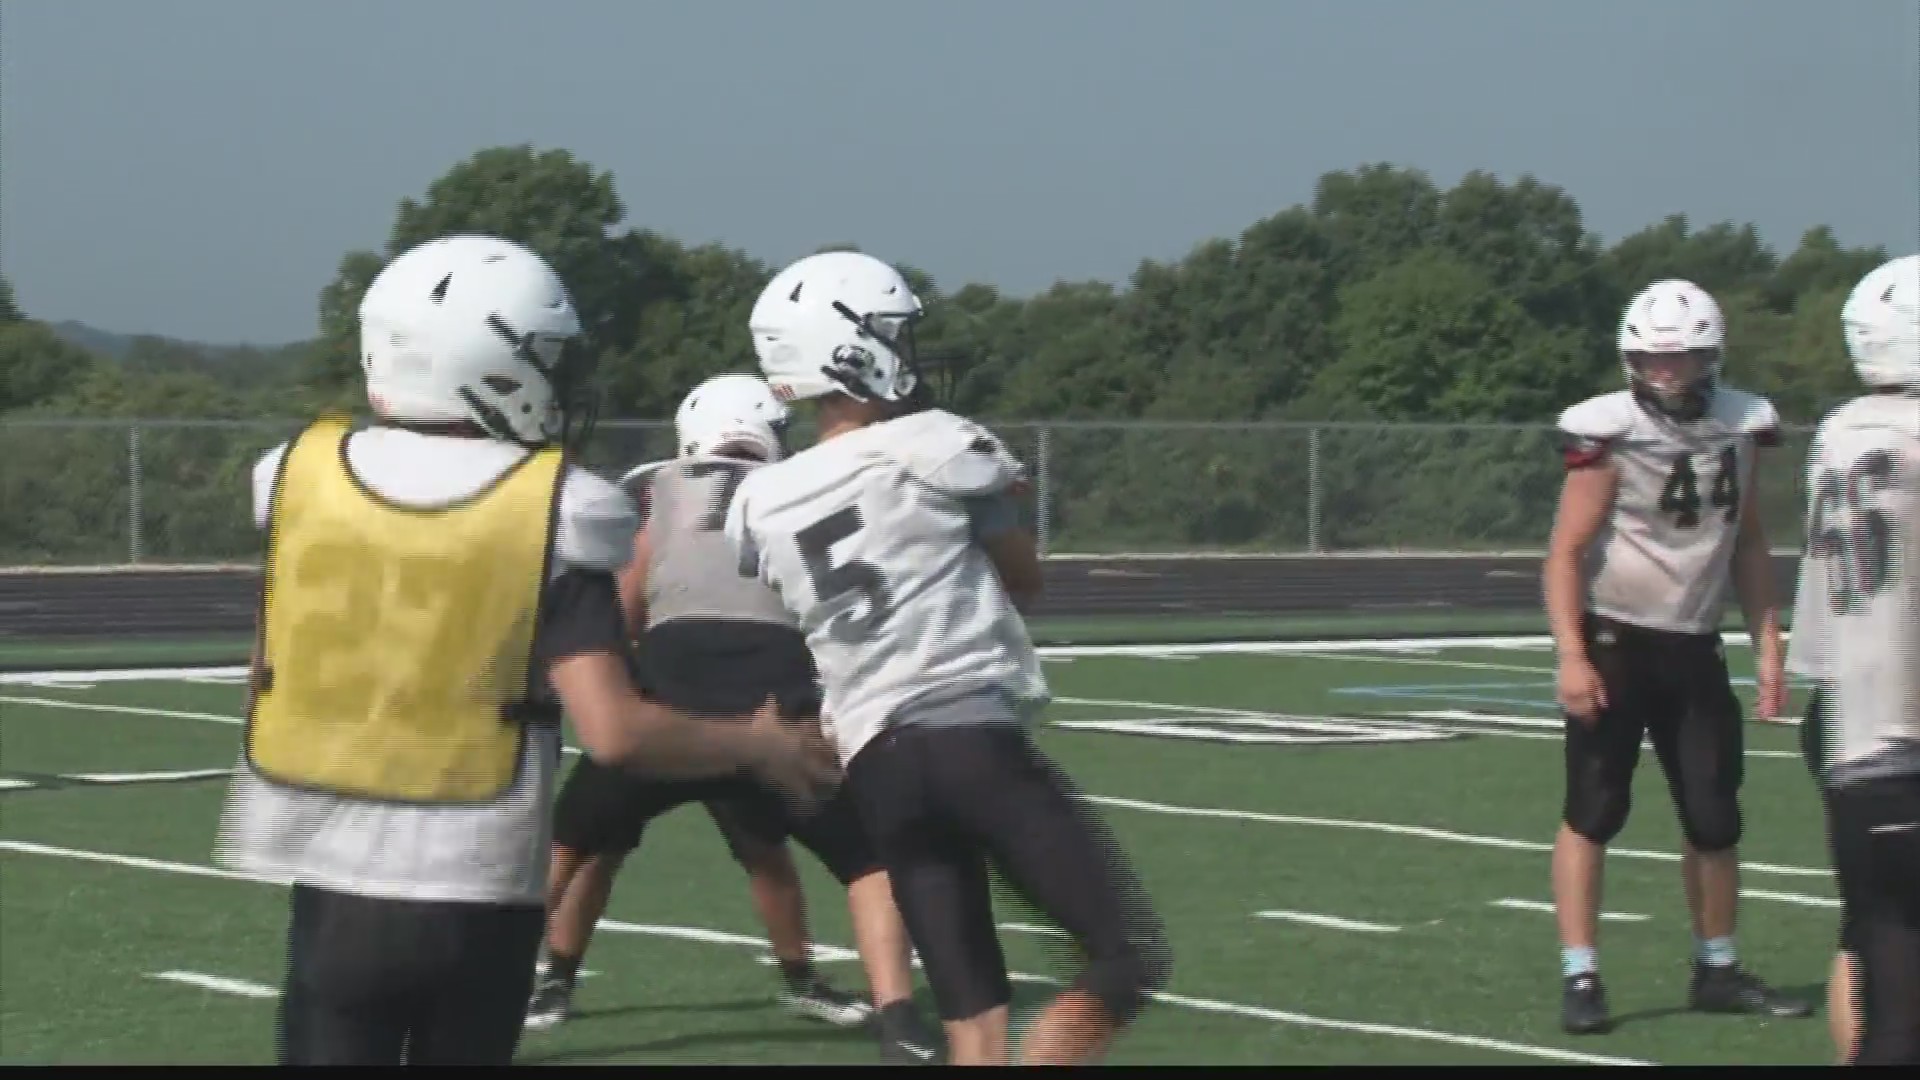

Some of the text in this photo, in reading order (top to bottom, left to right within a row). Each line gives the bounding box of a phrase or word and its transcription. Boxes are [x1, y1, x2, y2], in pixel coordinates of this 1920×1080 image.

[1658, 446, 1739, 528] 44
[287, 542, 500, 733] 27
[795, 504, 894, 641] 5
